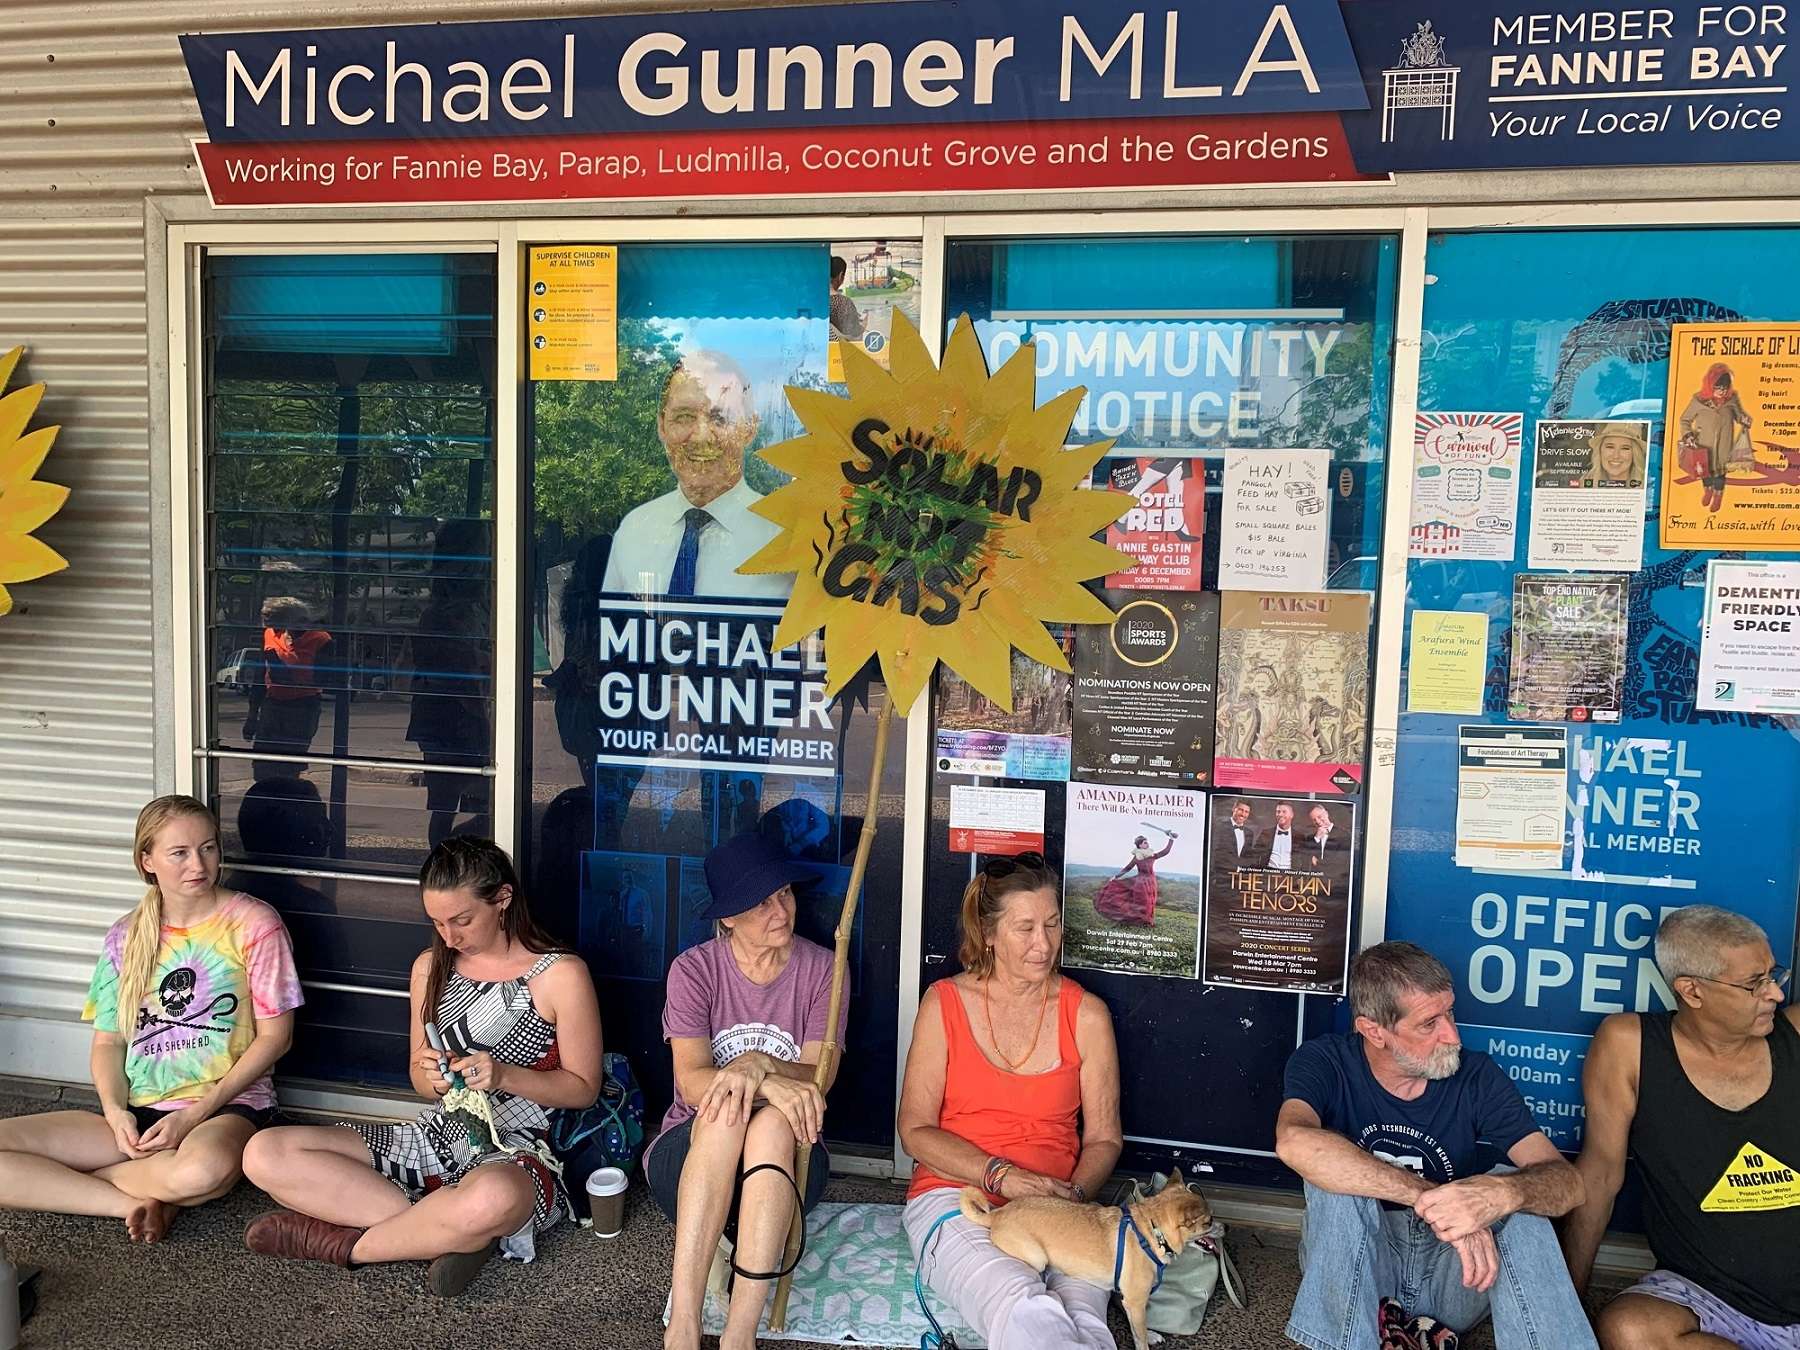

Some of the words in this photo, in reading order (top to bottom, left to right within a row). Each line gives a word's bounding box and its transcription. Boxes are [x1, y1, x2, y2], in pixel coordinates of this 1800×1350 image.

[1493, 9, 1674, 46] MEMBER
[1698, 4, 1787, 38] FOR
[225, 34, 574, 127] Michael
[618, 32, 1015, 116] Gunner
[1060, 4, 1320, 102] MLA
[1489, 48, 1664, 88] FANNIE
[1690, 44, 1787, 80] BAY
[1489, 110, 1565, 137] Your
[1577, 104, 1673, 136] Local
[1686, 101, 1782, 131] Voice
[225, 157, 335, 185] Working
[345, 156, 383, 181] for
[393, 153, 482, 179] Fannie
[494, 153, 548, 181] Bay,
[559, 150, 647, 178] Parap,
[659, 145, 790, 175] Ludmilla,
[802, 142, 932, 171] Coconut
[944, 139, 1036, 167] Grove
[1048, 136, 1107, 164] and
[1120, 135, 1173, 162] the
[1186, 132, 1328, 161] Gardens
[536, 251, 571, 260] SUPERVISE
[573, 251, 610, 259] CHILDREN
[1691, 336, 1716, 356] THE
[1720, 335, 1764, 356] SICKLE
[1768, 336, 1785, 355] OF
[990, 329, 1342, 378] COMMUNITY
[1761, 361, 1772, 369] Big
[1427, 434, 1499, 456] Carnival
[841, 418, 1042, 522] SOLAR
[1136, 493, 1184, 507] OTEL
[1237, 489, 1258, 498] FEED
[1265, 489, 1278, 497] HAY
[1128, 508, 1184, 532] RED
[1668, 514, 1697, 530] From
[1116, 543, 1148, 553] ANNIE
[1152, 543, 1191, 553] GASTIN
[1163, 555, 1190, 565] CLUB
[1142, 567, 1147, 575] 6
[1150, 567, 1191, 576] DECEMBER
[822, 542, 964, 626] GAS
[1543, 586, 1557, 595] TOP
[1557, 586, 1571, 595] END
[1572, 586, 1598, 596] NATIVE
[1259, 597, 1335, 612] TAKSU
[1556, 595, 1582, 606] PLANT
[1556, 607, 1580, 619] SALE
[1132, 620, 1153, 629] 2020
[1733, 619, 1791, 633] SPACE
[1131, 630, 1166, 638] SPORTS
[1418, 636, 1455, 644] Arafura
[1457, 636, 1482, 645] Wind
[1130, 638, 1166, 646] AWARDS
[1429, 647, 1469, 657] Ensemble
[1079, 678, 1151, 690] NOMINATIONS
[1153, 681, 1180, 690] NOW
[1182, 682, 1211, 692] OPEN
[599, 671, 834, 730] GUNNER
[1111, 725, 1152, 734] NOMINATE
[1154, 727, 1174, 735] NOW
[599, 728, 656, 751] YOUR
[663, 732, 731, 755] LOCAL
[738, 737, 833, 760] MEMBER
[1477, 748, 1510, 756] Foundations
[1527, 750, 1548, 759] Therapy
[1077, 788, 1135, 804] AMANDA
[1136, 792, 1194, 807] PALMER
[1076, 801, 1099, 812] There
[1101, 803, 1117, 813] Will
[1120, 805, 1130, 814] Be
[1132, 806, 1143, 815] No
[1145, 808, 1194, 818] Intermission
[1607, 833, 1701, 855] MEMBER
[1228, 871, 1264, 891] THE
[1266, 874, 1332, 896] ITALIAN
[1240, 890, 1317, 913] TENORS
[1471, 892, 1680, 950] OFFIC
[1086, 929, 1108, 937] Darwin
[1109, 931, 1151, 940] Entertainment
[1232, 950, 1254, 958] Darwin
[1255, 952, 1296, 960] Entertainment
[1468, 944, 1679, 1013] OPEN
[144, 1043, 162, 1056] SEA
[165, 1035, 210, 1051] SHEPHERD
[743, 1036, 768, 1047] OBEY
[1488, 1038, 1571, 1065] Monday
[1743, 1154, 1764, 1168] NO
[1726, 1169, 1794, 1188] FRACKING
